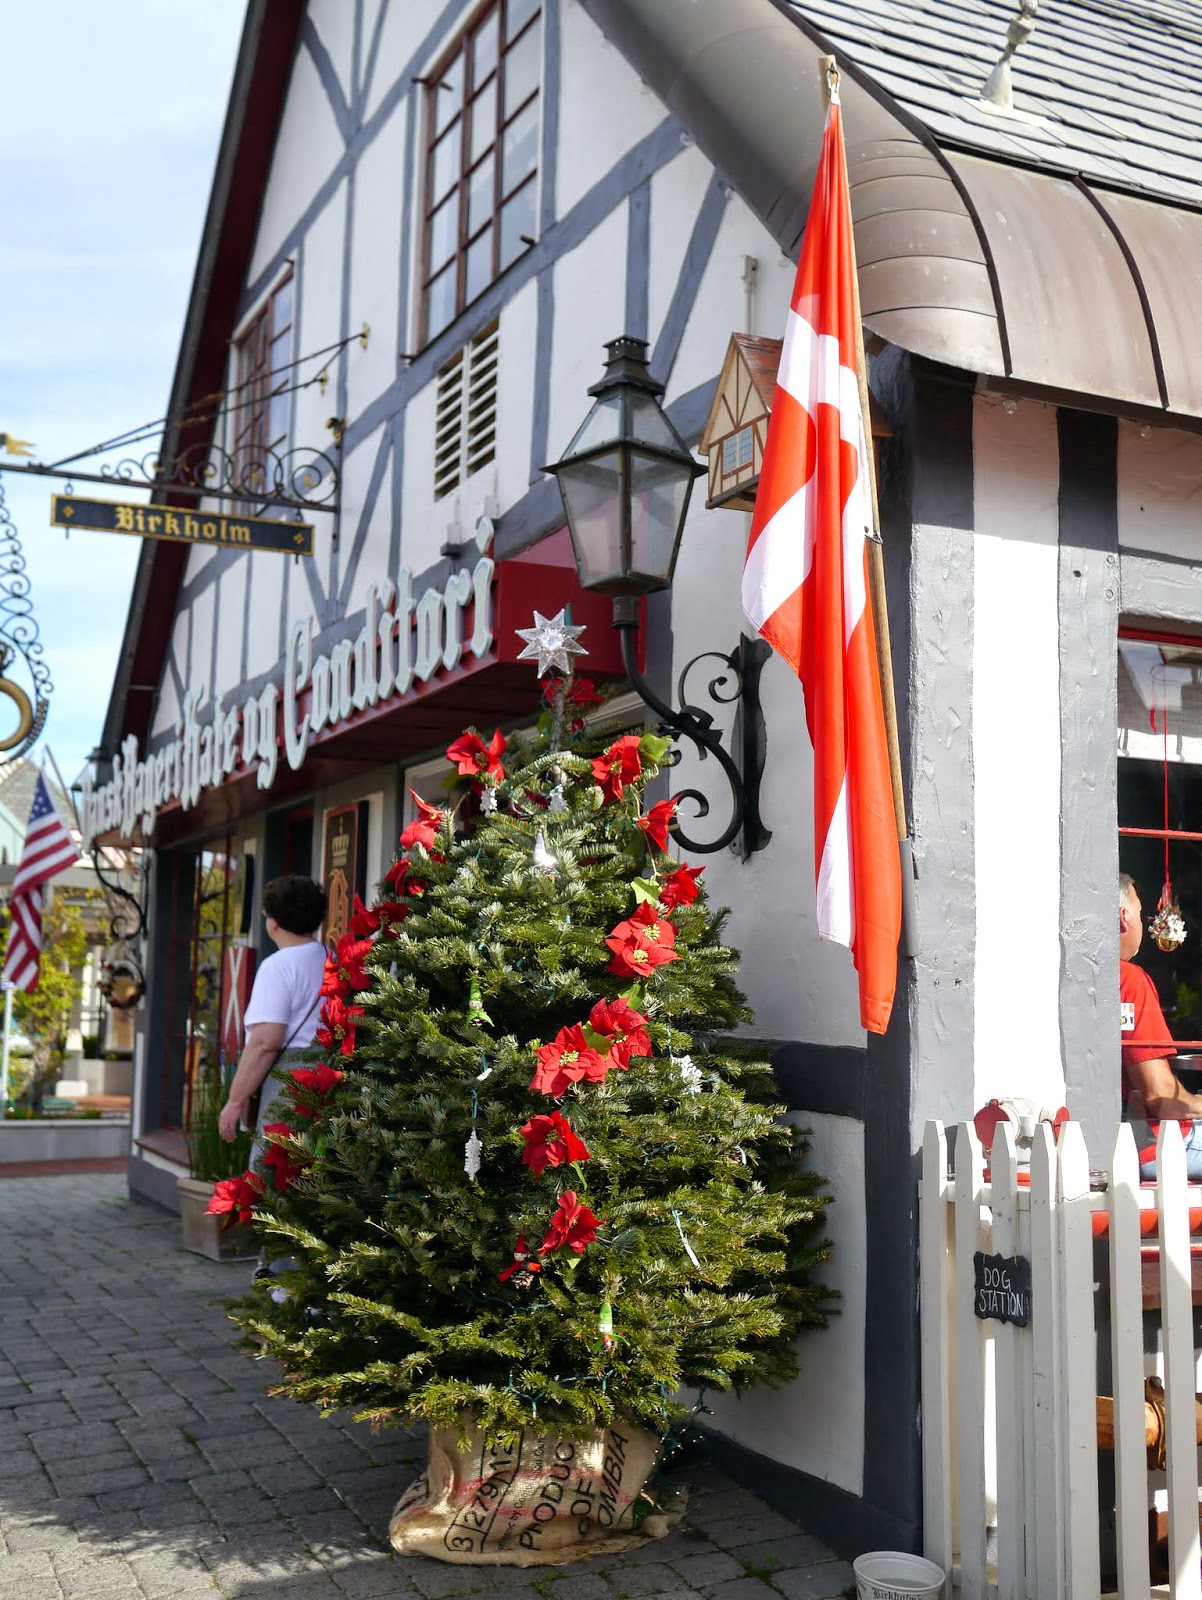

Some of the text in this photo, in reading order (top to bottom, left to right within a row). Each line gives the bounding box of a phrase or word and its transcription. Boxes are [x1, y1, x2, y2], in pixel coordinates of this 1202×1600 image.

[114, 505, 252, 544] Birkholm
[120, 719, 184, 839] Bageri
[241, 682, 278, 791] og
[283, 515, 496, 772] Conditori
[983, 1266, 1012, 1293] DOG
[978, 1288, 1025, 1317] STATION
[518, 1440, 576, 1551] PRODUC
[569, 1477, 597, 1517] OF
[451, 1536, 474, 1552] 3
